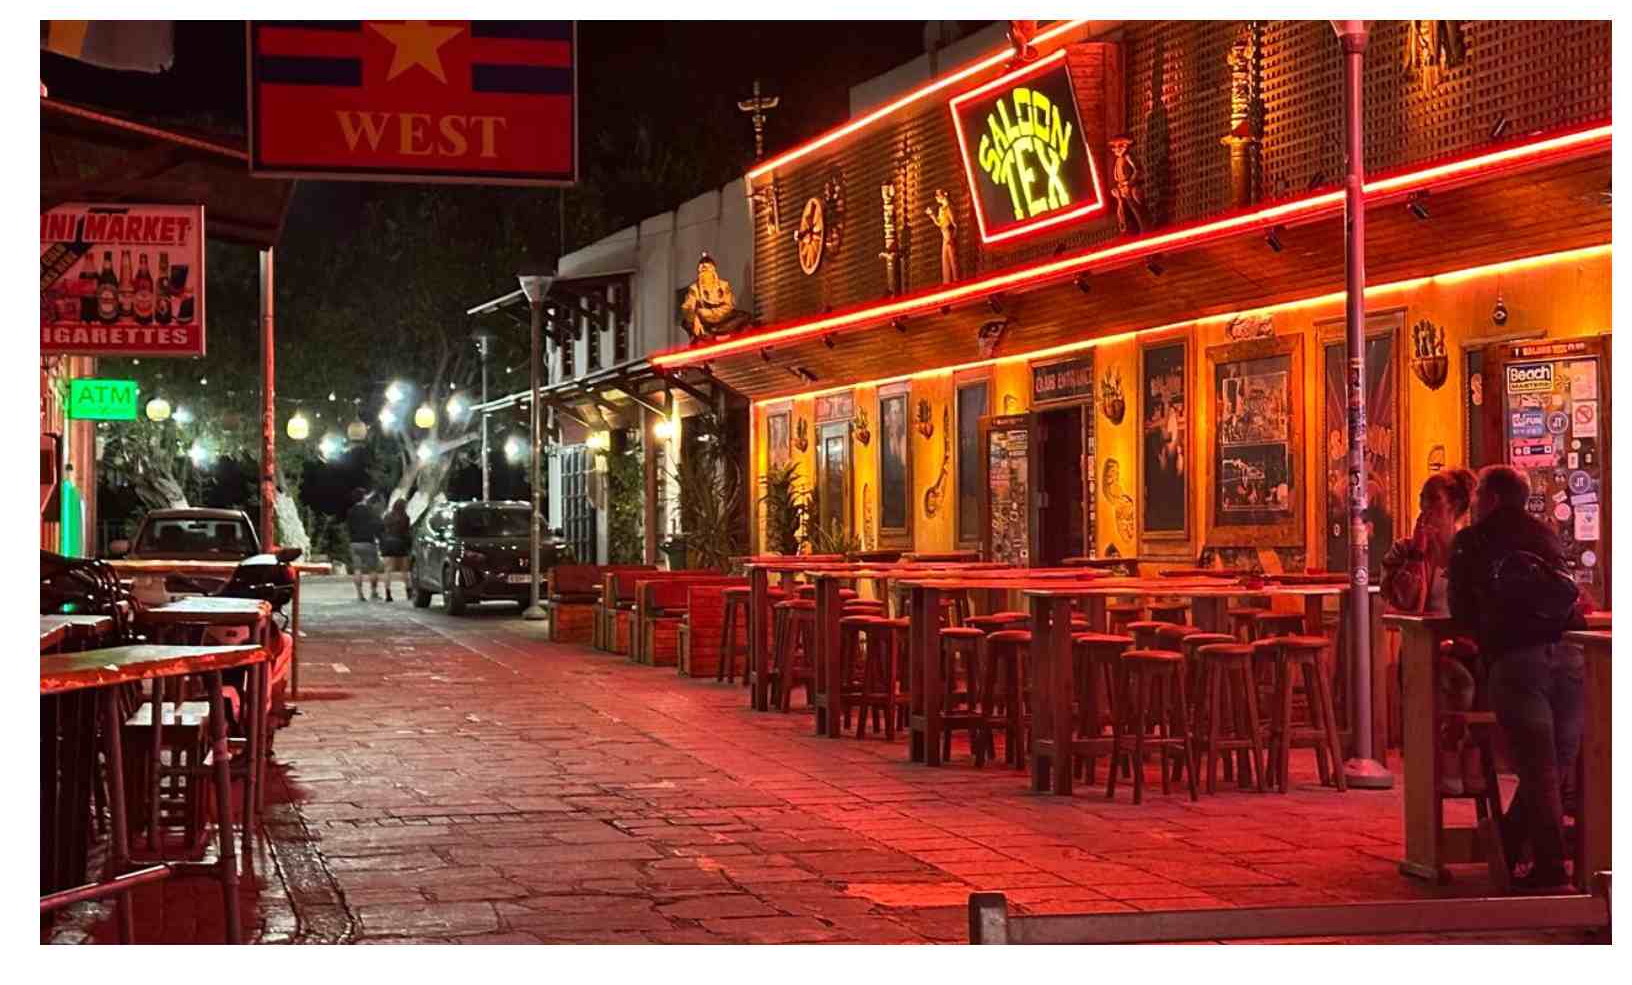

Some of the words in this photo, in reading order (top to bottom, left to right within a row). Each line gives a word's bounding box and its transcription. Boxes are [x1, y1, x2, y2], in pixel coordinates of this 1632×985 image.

[335, 110, 507, 158] WEST
[978, 87, 1073, 185] SALOON
[1000, 136, 1071, 221] TEX
[40, 213, 77, 242] INI
[84, 213, 192, 244] MARKET
[43, 326, 188, 344] IGARETTES
[1510, 365, 1551, 382] Beach
[79, 386, 130, 405] ATM
